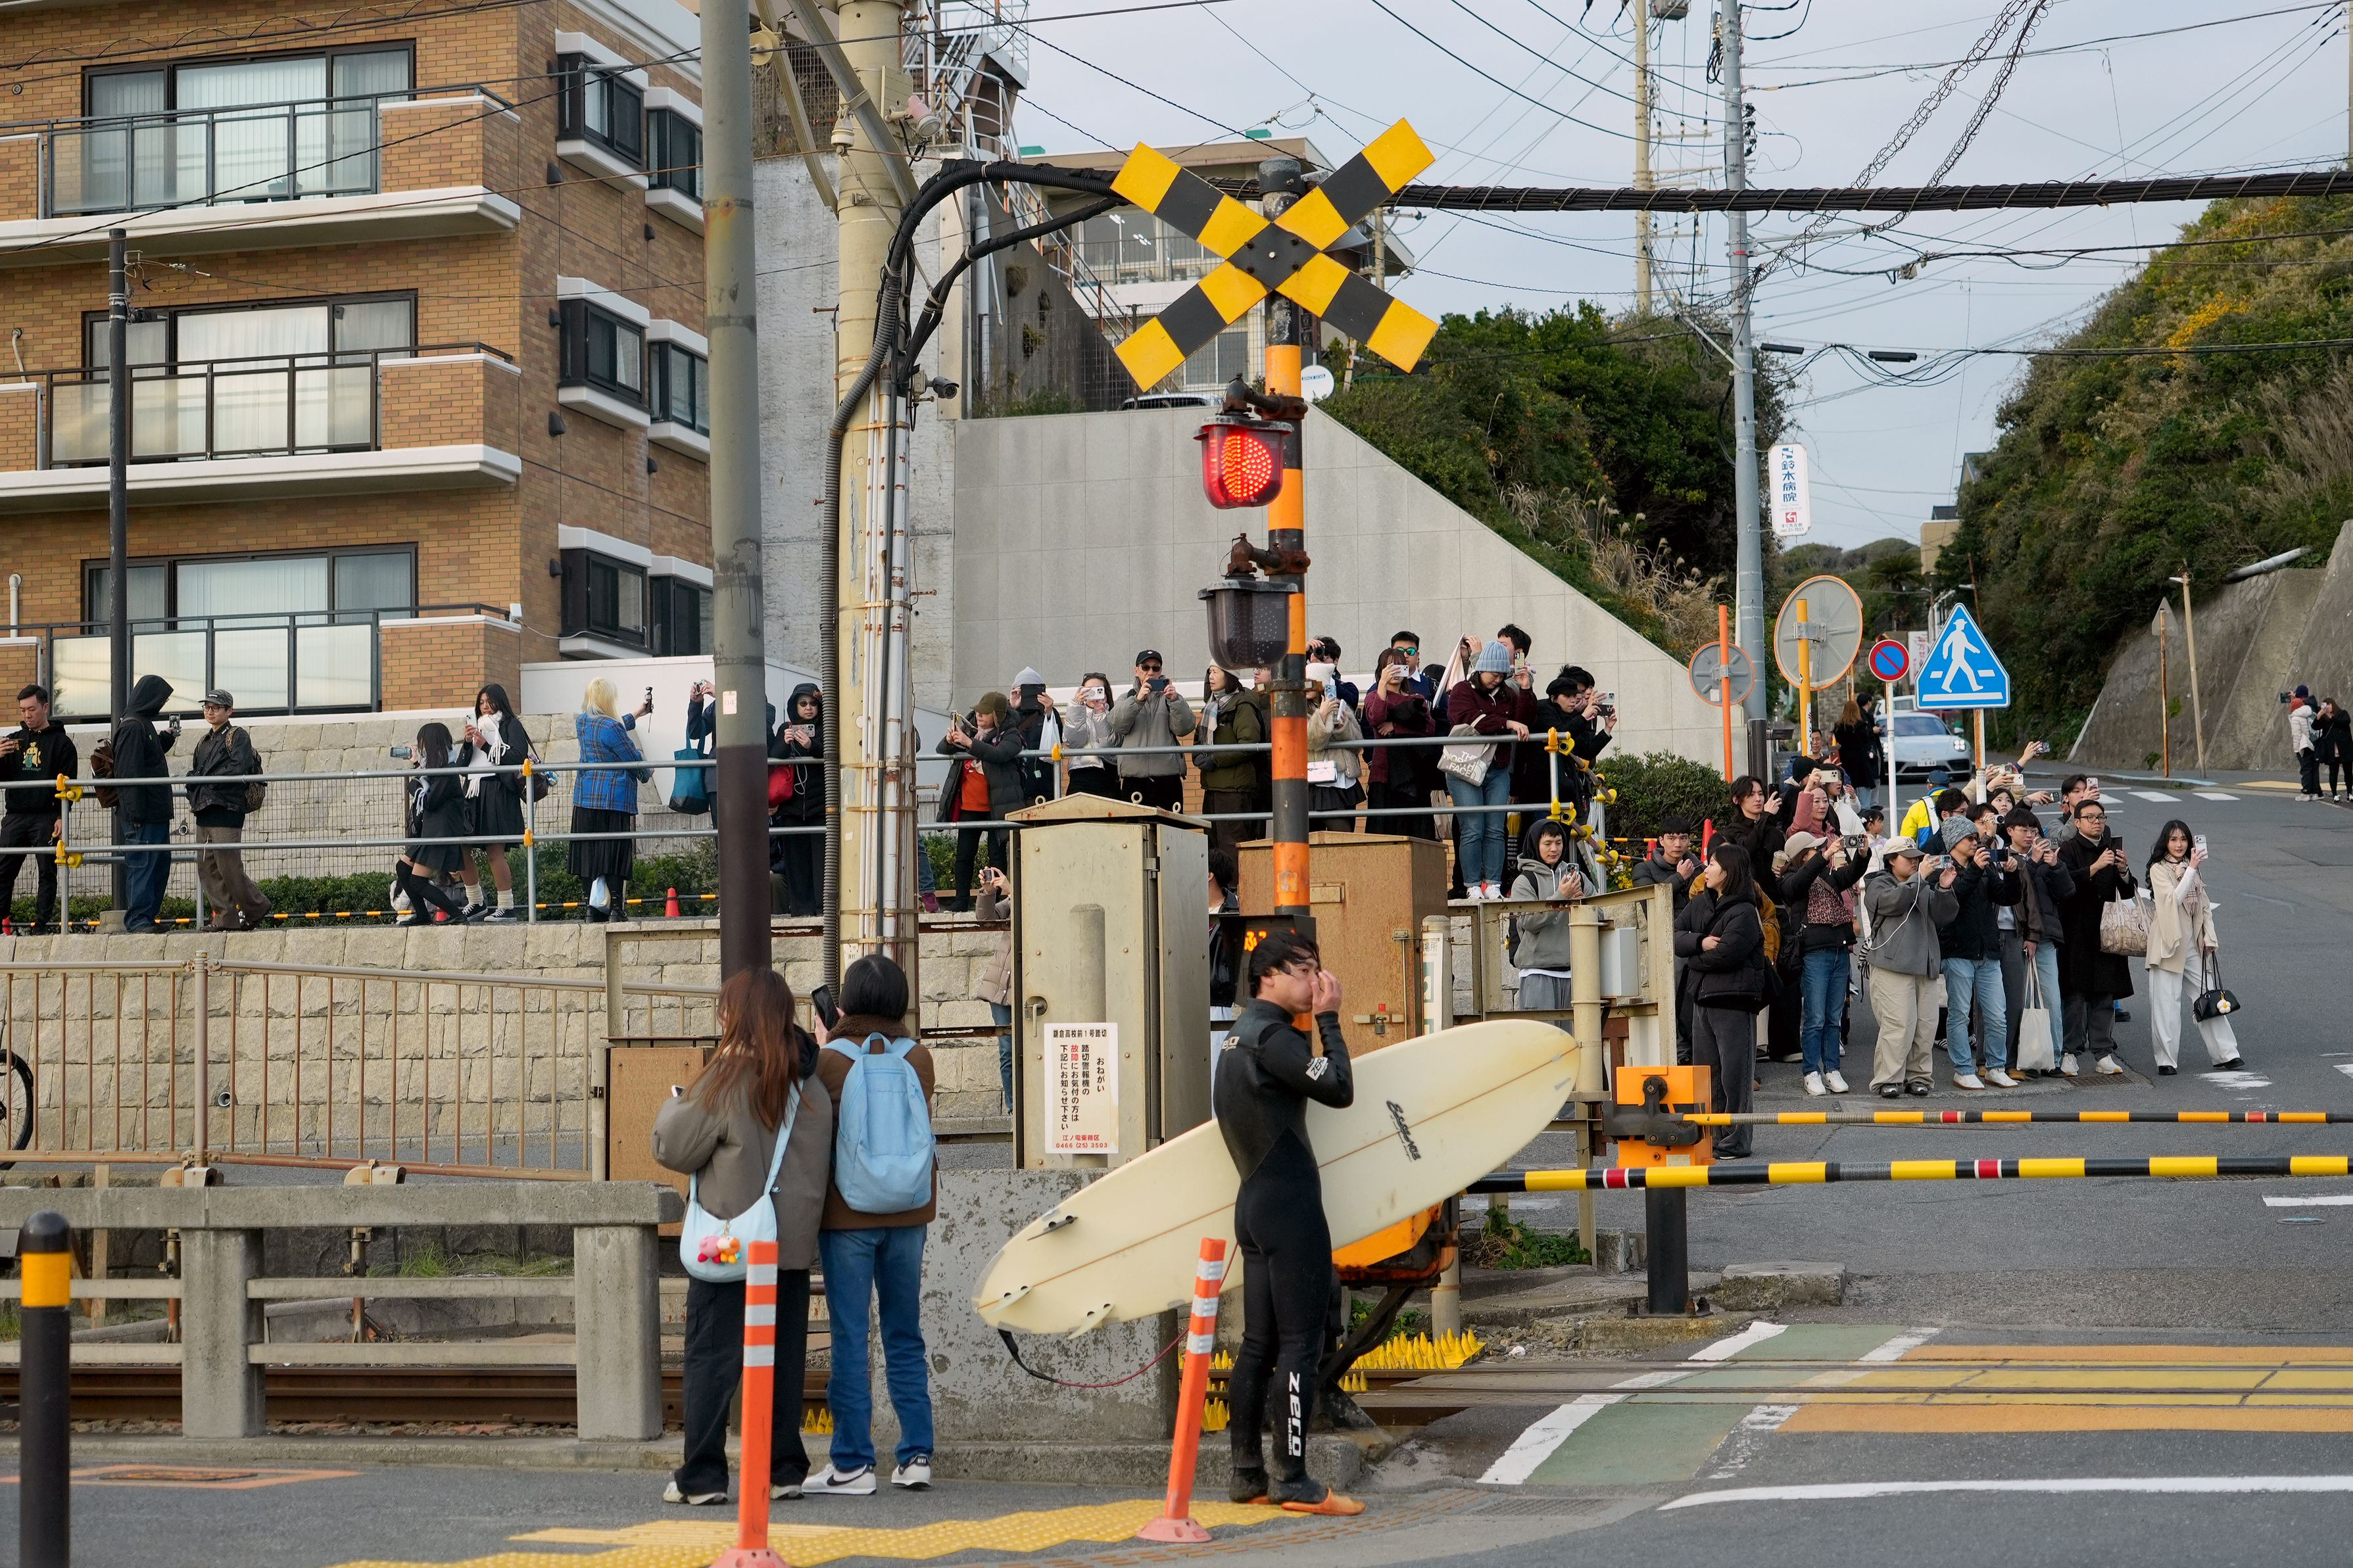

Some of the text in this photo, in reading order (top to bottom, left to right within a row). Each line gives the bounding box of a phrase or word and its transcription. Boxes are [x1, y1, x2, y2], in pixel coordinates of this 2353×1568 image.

[1782, 460, 1797, 502] 鈴木病院
[1449, 762, 1473, 778] FACE
[1060, 1045, 1069, 1130] 下記にお知らせ下さい
[1071, 1044, 1079, 1122] 故障にお気付の方は
[1081, 1044, 1090, 1095] 踏切警報機の
[1096, 1057, 1105, 1092] おねがい
